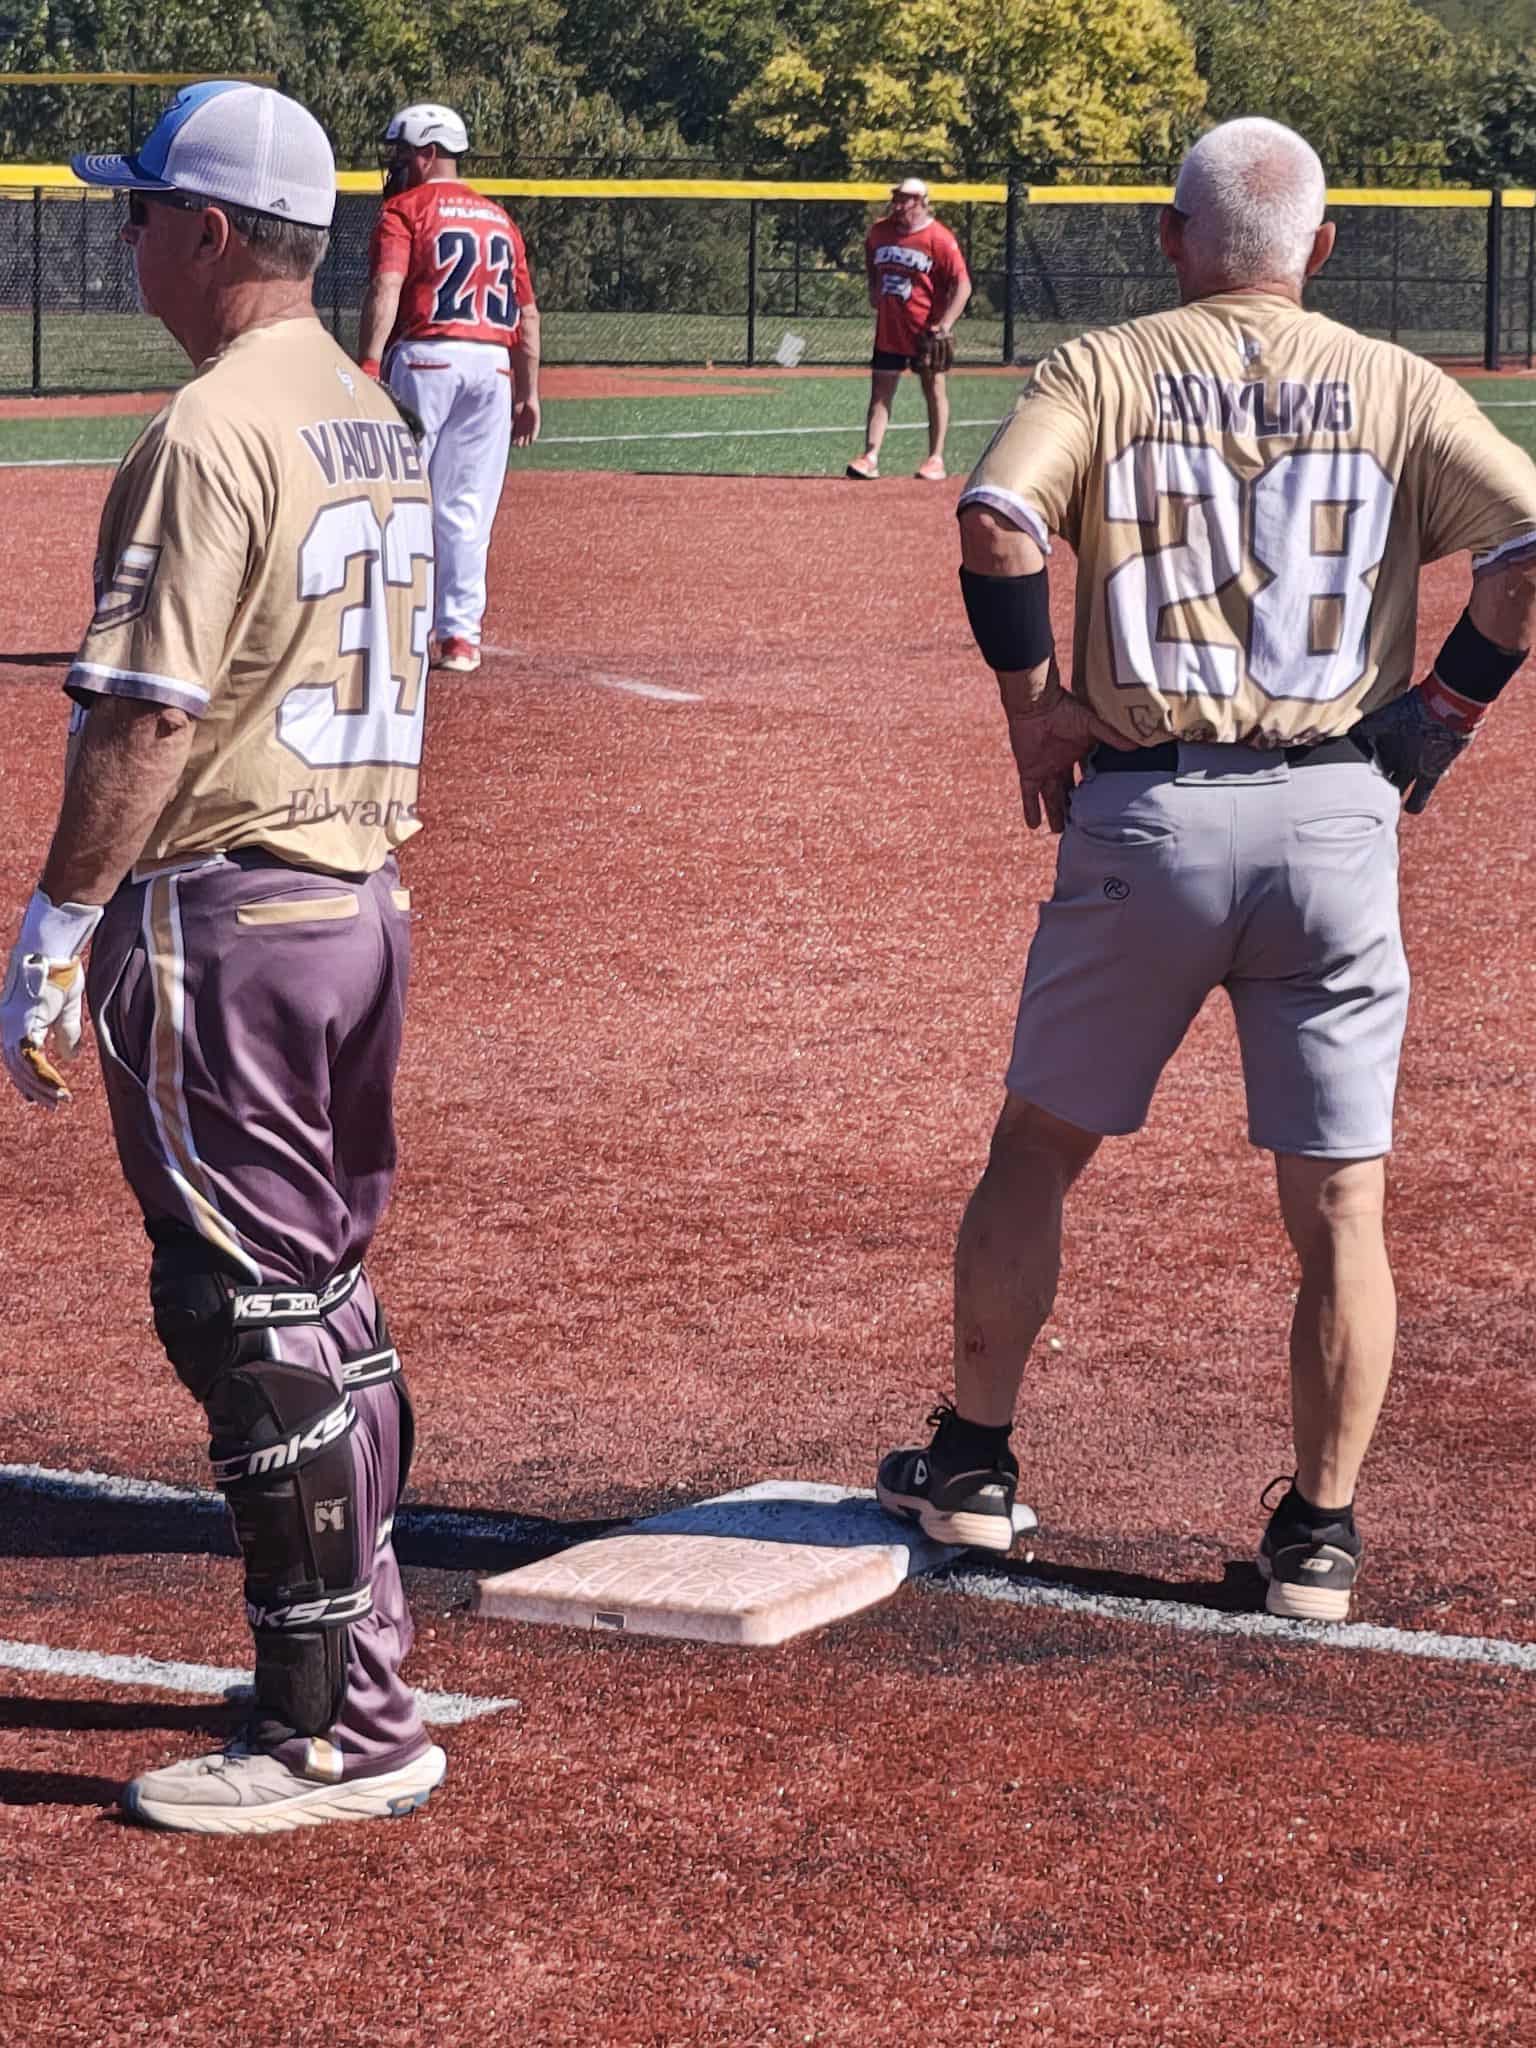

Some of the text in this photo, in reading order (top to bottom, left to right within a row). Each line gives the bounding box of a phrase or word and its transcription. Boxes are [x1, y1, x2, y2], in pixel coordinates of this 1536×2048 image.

[428, 225, 520, 332] 23
[276, 494, 436, 770] 33
[1104, 436, 1394, 704] 28
